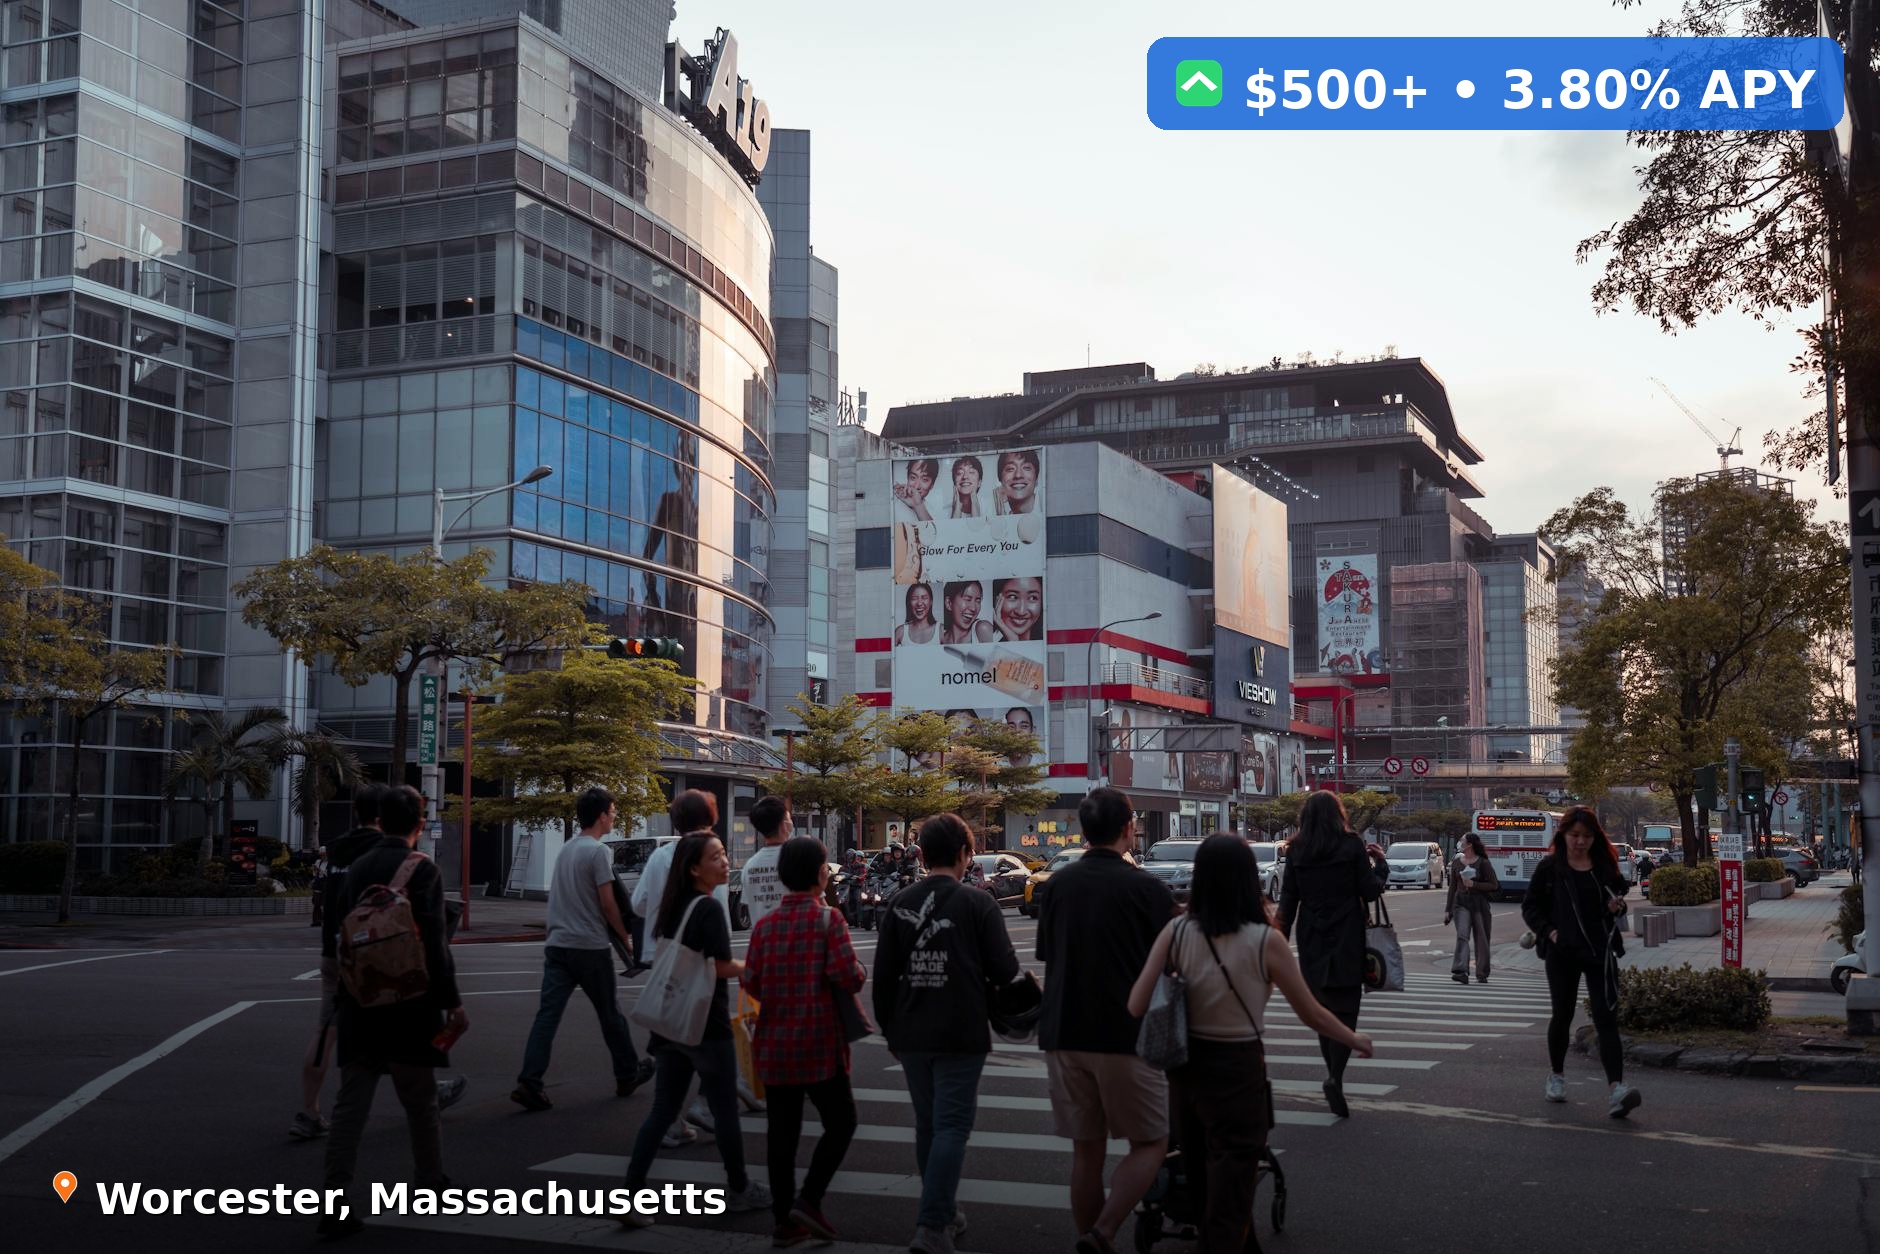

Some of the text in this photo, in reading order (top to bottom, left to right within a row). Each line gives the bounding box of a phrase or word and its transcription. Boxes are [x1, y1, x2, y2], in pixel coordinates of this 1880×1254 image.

[707, 29, 771, 172] A19
[919, 541, 1019, 556] Glow For Every You
[1343, 561, 1352, 624] SAKURA
[941, 668, 996, 685] nomel
[1238, 680, 1277, 705] VIESHOW
[1038, 821, 1067, 833] NEW
[1478, 816, 1496, 829] 912
[1021, 834, 1080, 847] BALANCE
[1517, 852, 1543, 860] 161-U3
[747, 867, 769, 876] HUMAN
[749, 877, 761, 885] THE
[766, 893, 782, 901] PAST
